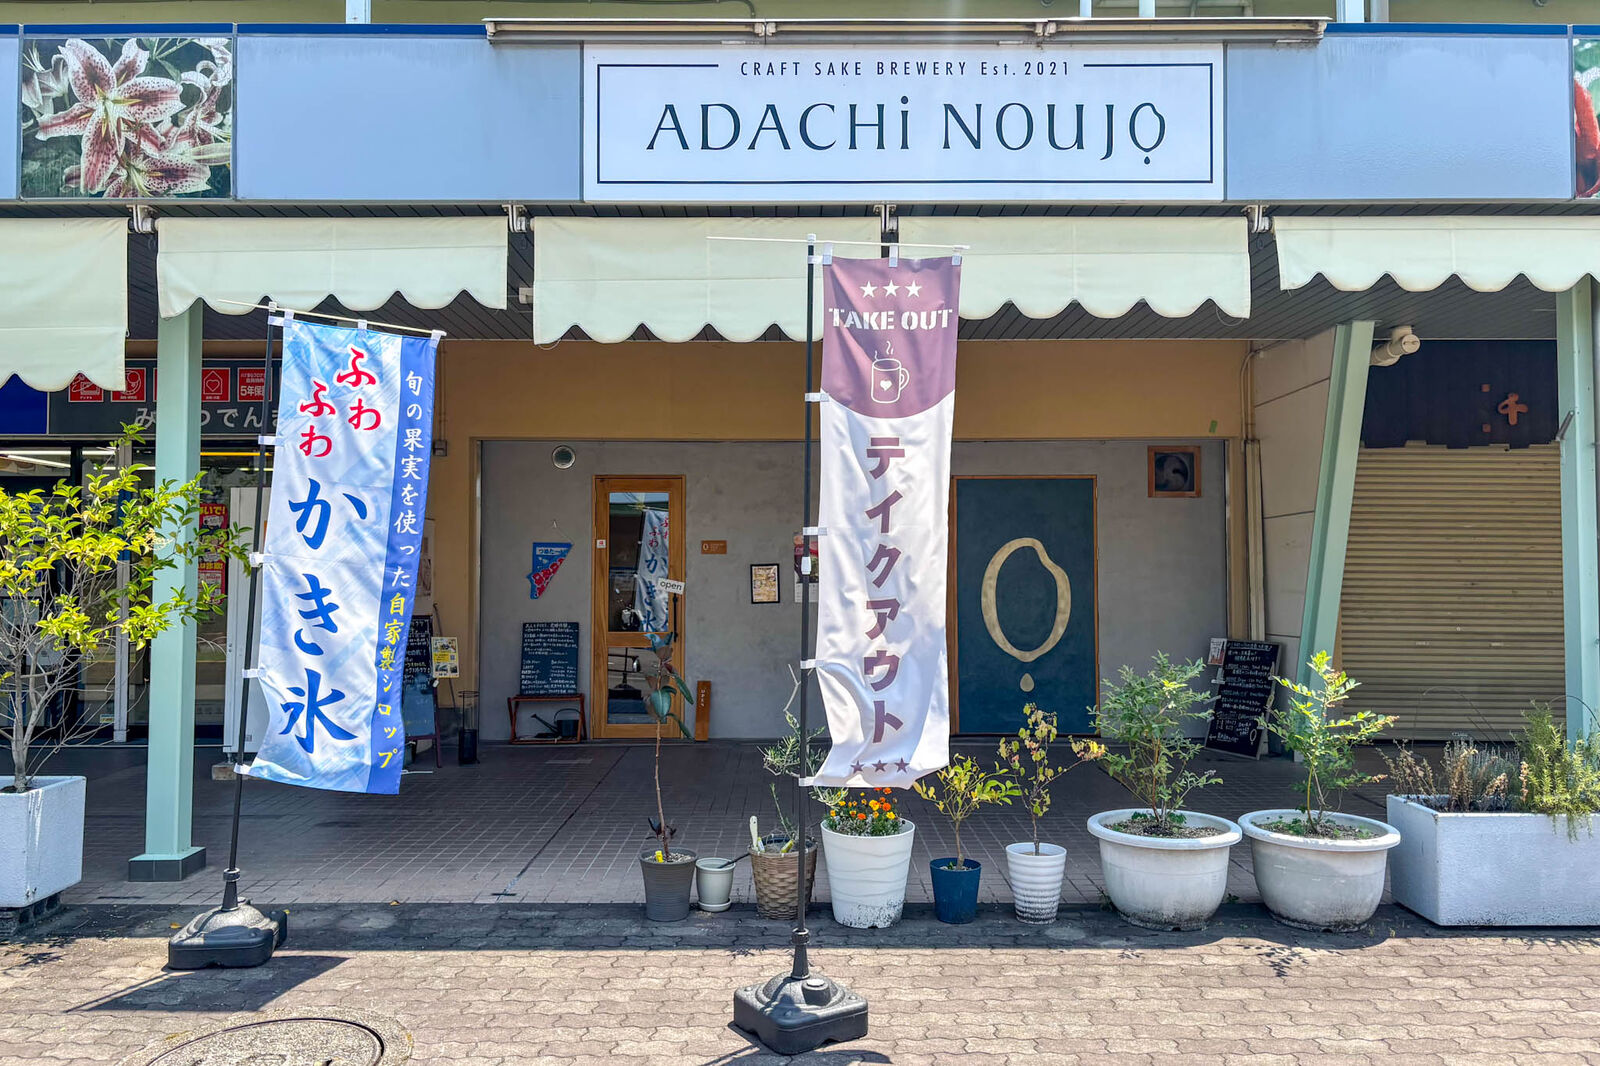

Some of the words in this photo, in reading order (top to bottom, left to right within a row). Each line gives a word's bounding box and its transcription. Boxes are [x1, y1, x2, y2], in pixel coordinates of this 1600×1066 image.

[741, 61, 800, 76] CRAFT
[814, 61, 862, 76] SAKE
[876, 61, 967, 76] BREWERY
[980, 61, 1017, 76] Est.
[1024, 61, 1070, 76] 2021
[942, 102, 1166, 165] NOUJO
[828, 307, 896, 331] TAKE
[901, 308, 953, 330] OUT
[299, 380, 336, 458] ふわ
[336, 347, 382, 431] ふわ
[278, 477, 368, 754] かき氷
[660, 580, 682, 591] open
[864, 436, 906, 744] テイクアウト
